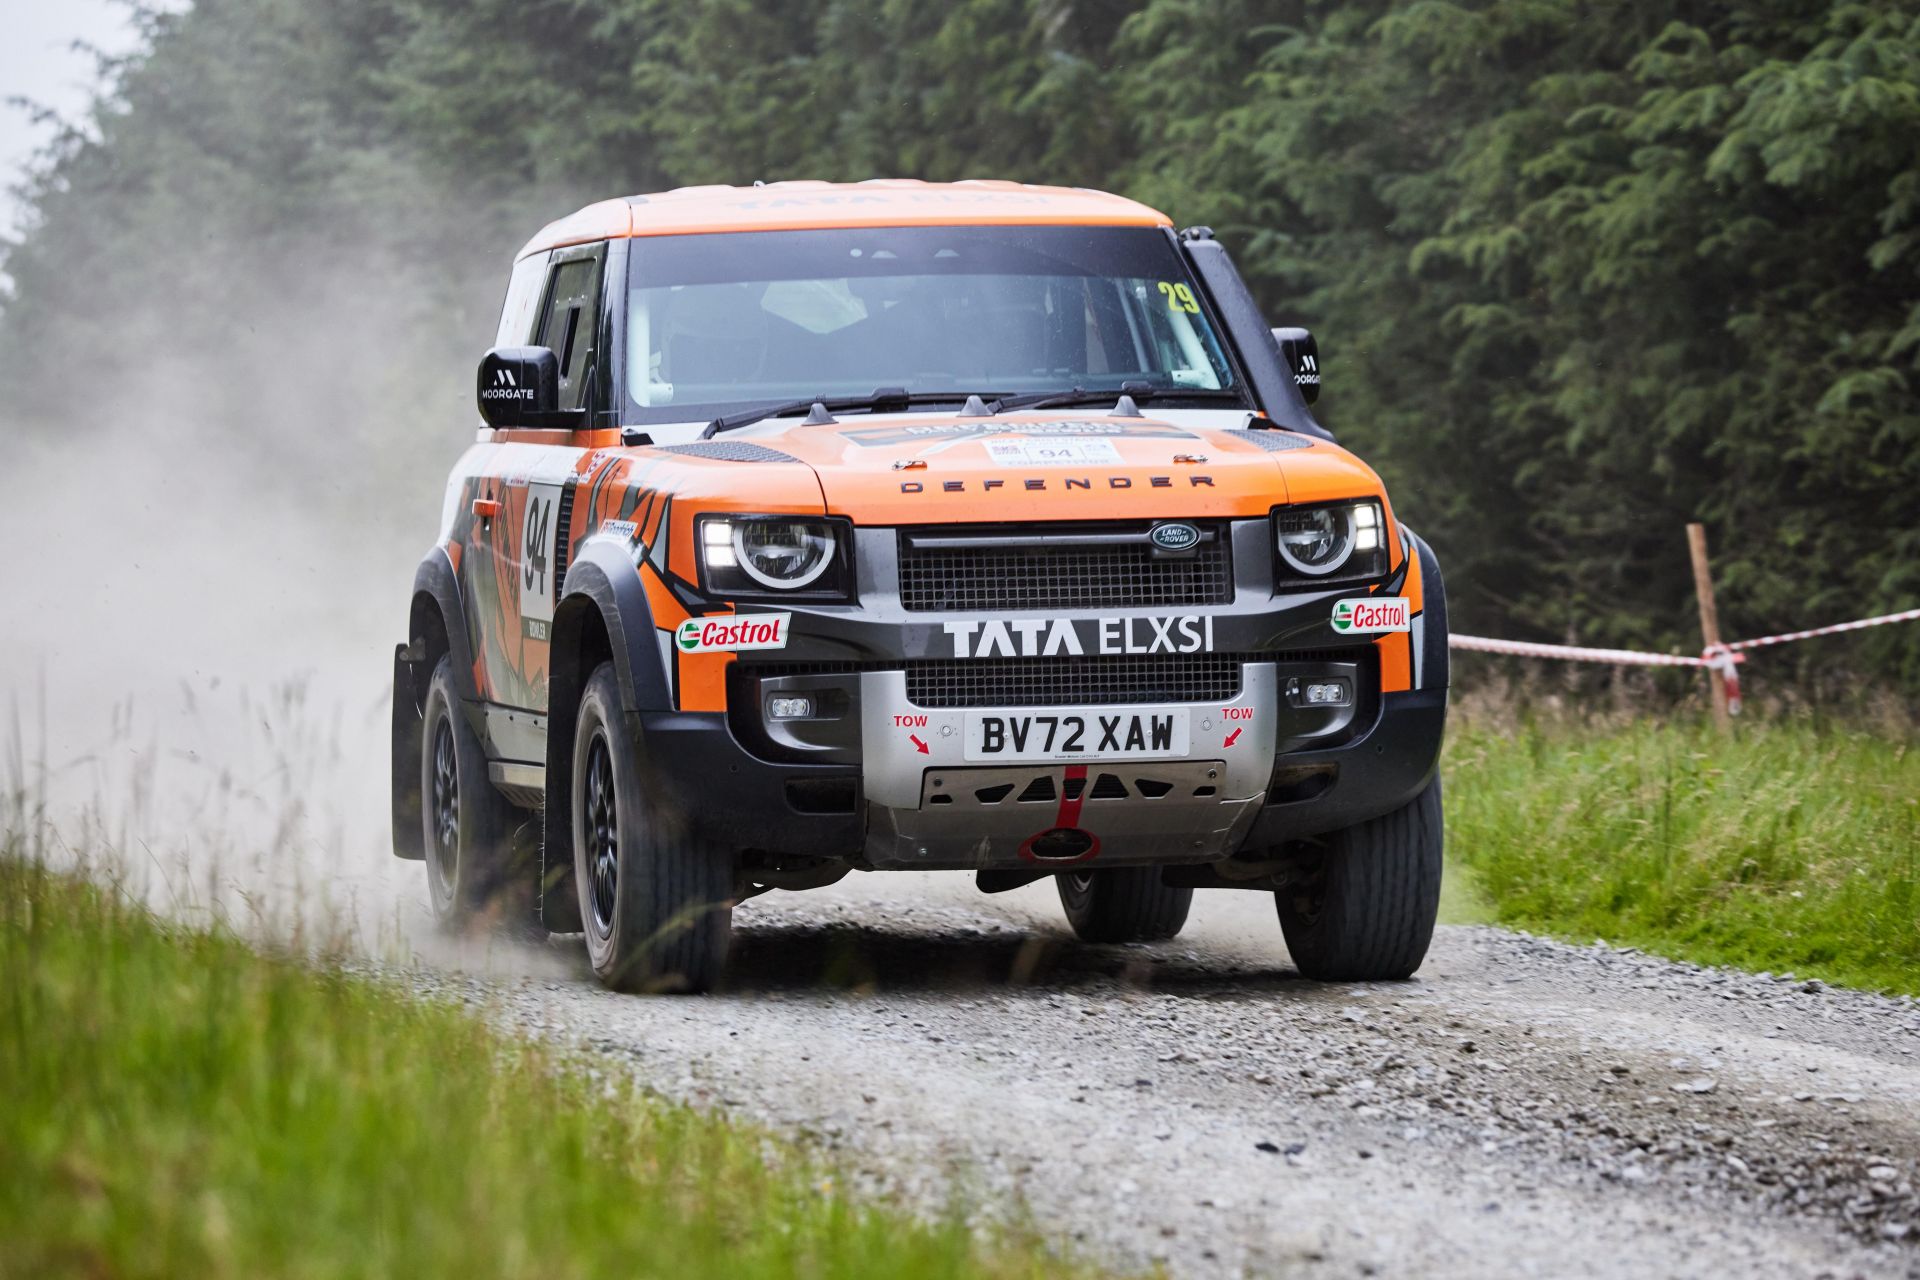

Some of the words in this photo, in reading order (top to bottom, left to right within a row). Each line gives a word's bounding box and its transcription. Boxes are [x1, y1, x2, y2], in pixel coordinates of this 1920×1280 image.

[1158, 281, 1200, 314] 29
[482, 389, 534, 399] MOORGATE
[1039, 449, 1073, 457] 94
[900, 476, 1216, 494] DEFENDER
[525, 496, 551, 595] 94
[1354, 604, 1406, 628] Castrol
[702, 619, 780, 647] Castrol
[944, 619, 1084, 658] TATA
[1099, 615, 1214, 654] ELXSI
[893, 715, 929, 728] TOW
[1221, 707, 1254, 721] TOW
[981, 716, 1085, 754] BV72
[1098, 714, 1174, 752] XAW
